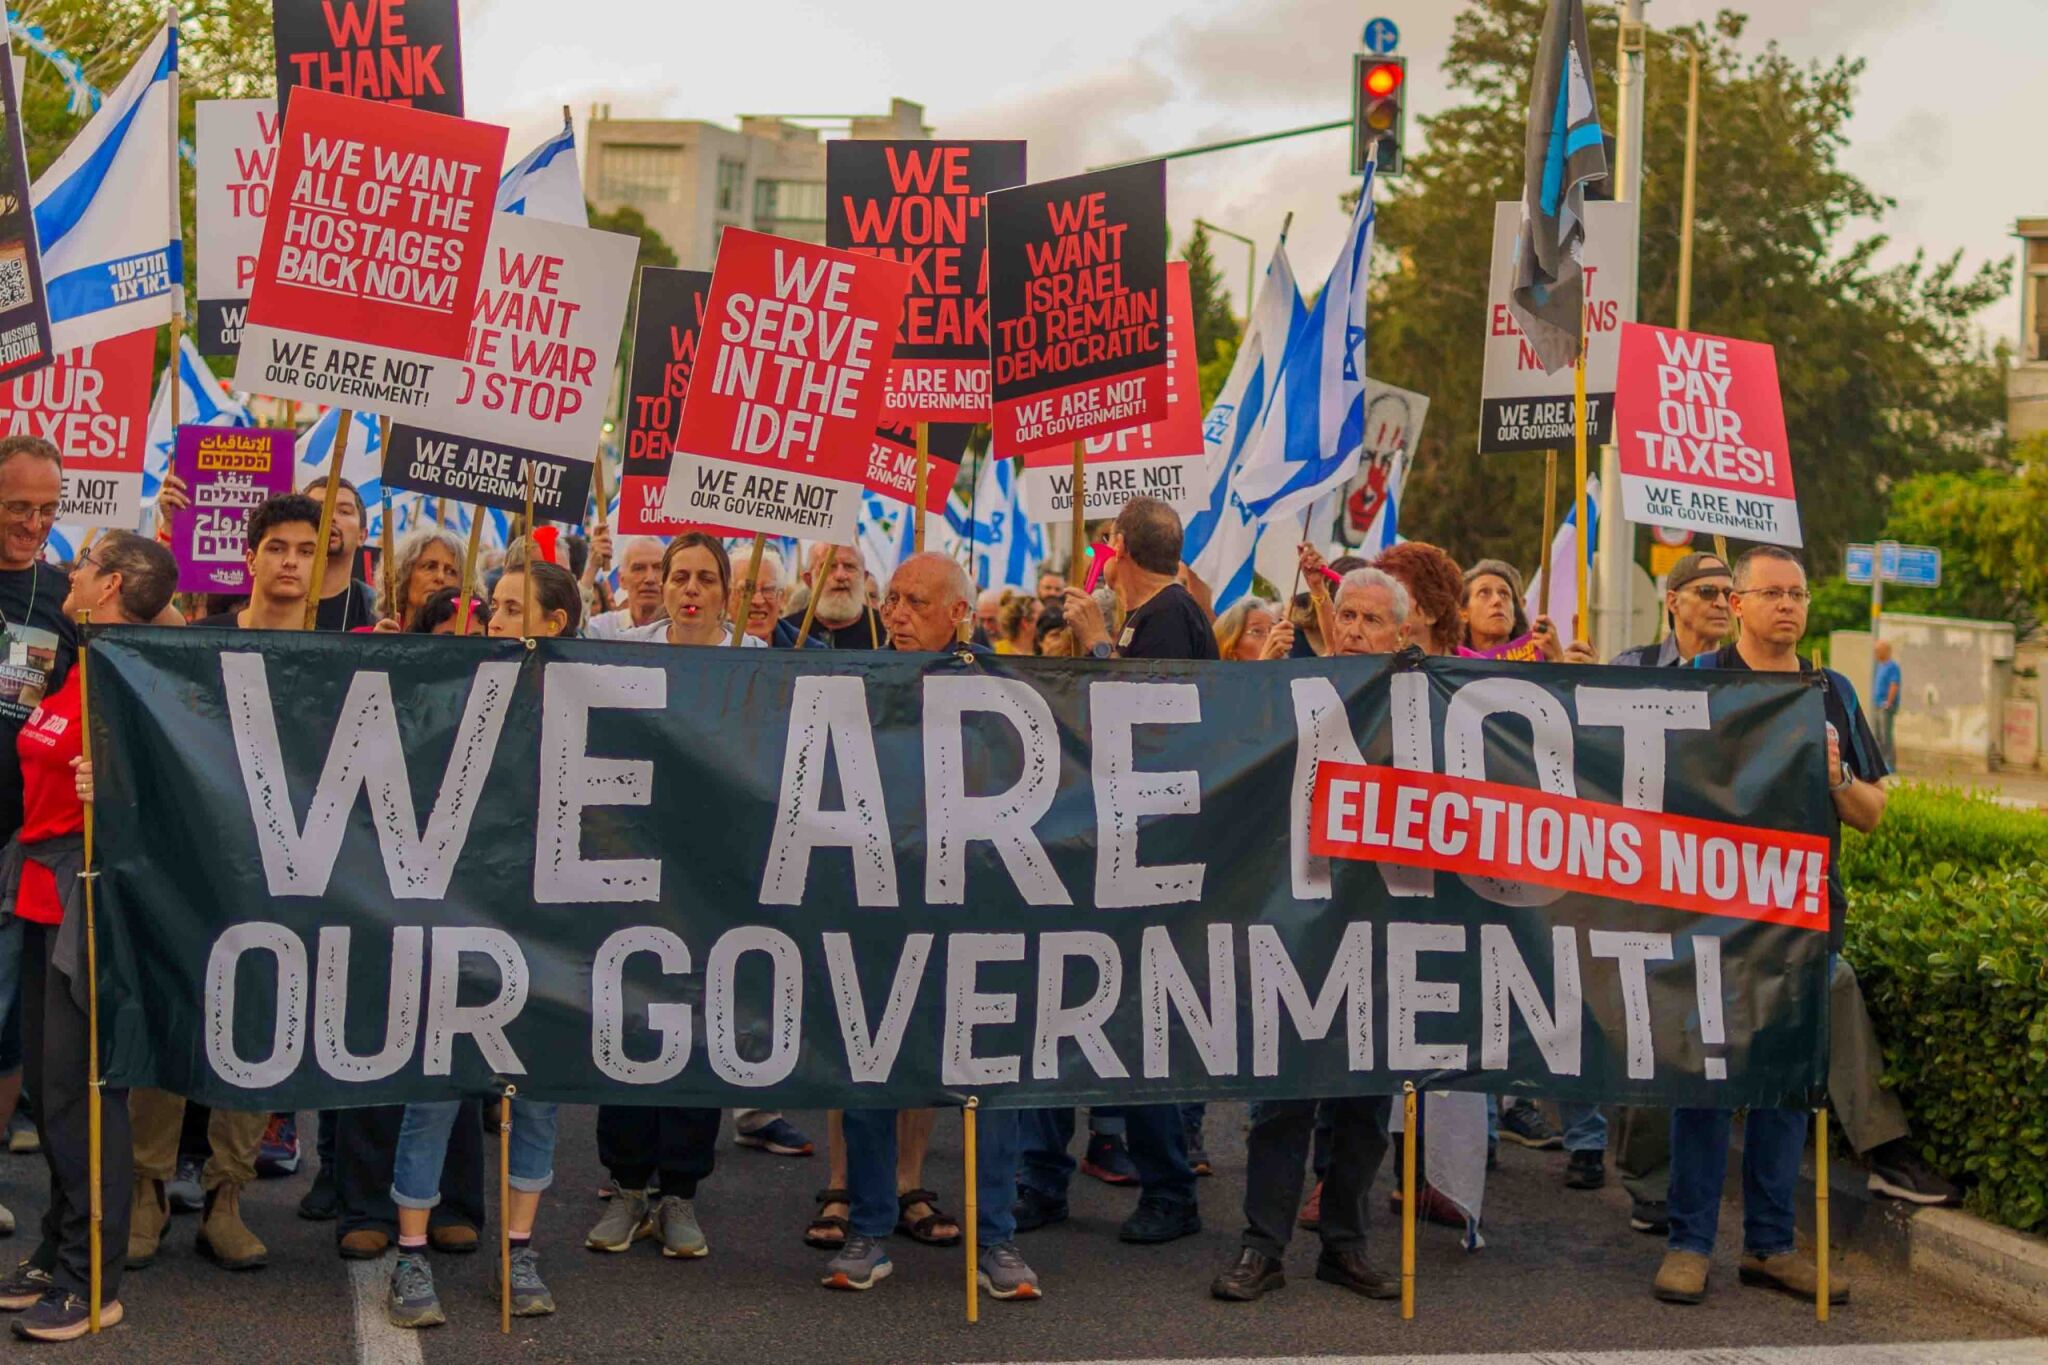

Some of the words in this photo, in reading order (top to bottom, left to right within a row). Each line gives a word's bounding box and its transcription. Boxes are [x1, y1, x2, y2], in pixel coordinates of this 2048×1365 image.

[322, 0, 407, 47] WE
[290, 45, 446, 95] THANK
[303, 133, 364, 176] WE
[374, 147, 481, 196] WANT
[885, 147, 970, 194] WE
[227, 184, 268, 217] TO
[291, 172, 348, 210] ALL
[357, 181, 402, 217] OF
[409, 190, 473, 232] THE
[843, 195, 988, 245] WON'
[1047, 192, 1106, 236] WE
[284, 211, 464, 273] HOSTAGES
[1025, 224, 1128, 277] WANT
[108, 251, 168, 282] חופשי
[111, 271, 171, 303] בארצנו
[277, 246, 362, 292] BACK
[362, 263, 459, 308] NOW!
[499, 247, 564, 295] WE
[774, 248, 856, 312] WE
[1024, 263, 1129, 315] ISRAEL
[2, 322, 37, 346] MISSING
[472, 289, 580, 339] WANT
[721, 293, 878, 370] SERVE
[997, 315, 1037, 353] TO
[1046, 288, 1158, 343] REMAIN
[0, 335, 41, 366] FORUM
[272, 339, 317, 369] WE
[325, 349, 375, 378] ARE
[383, 357, 434, 389] NOT
[511, 334, 597, 386] WAR
[996, 321, 1160, 385] DEMOCRATIC
[1656, 331, 1731, 374] WE
[13, 366, 104, 413] OUR
[265, 365, 298, 386] OUR
[304, 373, 430, 408] GOVERNMENT!
[482, 372, 582, 423] STOP
[711, 344, 764, 399] IN
[773, 355, 864, 419] THE
[886, 392, 992, 409] GOVERNMENT
[901, 369, 947, 392] ARE
[1015, 400, 1054, 427] WE
[1060, 387, 1100, 417] ARE
[1106, 376, 1146, 401] NOT
[1658, 364, 1732, 408] PAY
[0, 409, 130, 459] AXES!
[636, 397, 671, 430] TO
[731, 401, 824, 463] IDF!
[1015, 424, 1043, 443] OUR
[1047, 400, 1147, 435] GOVERNMENT!
[1497, 427, 1519, 441] OUR
[1522, 421, 1598, 440] GOVERNMT!
[1499, 404, 1529, 426] WE
[1533, 402, 1566, 424] ARE
[1659, 400, 1744, 446] OUR
[201, 453, 268, 467] הסכמים
[409, 462, 440, 483] OUR
[415, 437, 459, 471] WE
[463, 448, 514, 477] ARE
[520, 456, 567, 490] NOT
[1050, 472, 1087, 494] W
[1096, 469, 1136, 492] ARE
[1143, 465, 1183, 488] NOT
[1635, 430, 1776, 486] TAXES!
[77, 479, 119, 500] NOT
[200, 487, 265, 503] מצילים
[690, 491, 720, 510] OUR
[724, 497, 834, 529] GOVERNMENT!
[698, 466, 738, 495] WE
[743, 475, 789, 504] ARE
[794, 483, 838, 511] NOT
[1645, 484, 1682, 506] WE
[1691, 492, 1729, 514] ARE
[1736, 499, 1774, 520] NOT
[1647, 502, 1673, 517] OUR
[1678, 507, 1778, 533] GOVERNMENT!
[219, 651, 667, 903] WE
[758, 675, 1206, 908] ARE
[1290, 671, 1711, 907] NOT
[1326, 778, 1643, 886] ELECTIONS
[1659, 830, 1824, 914] NOW!
[205, 921, 529, 1089] OUR
[592, 921, 1727, 1087] GOVERNMENT!
